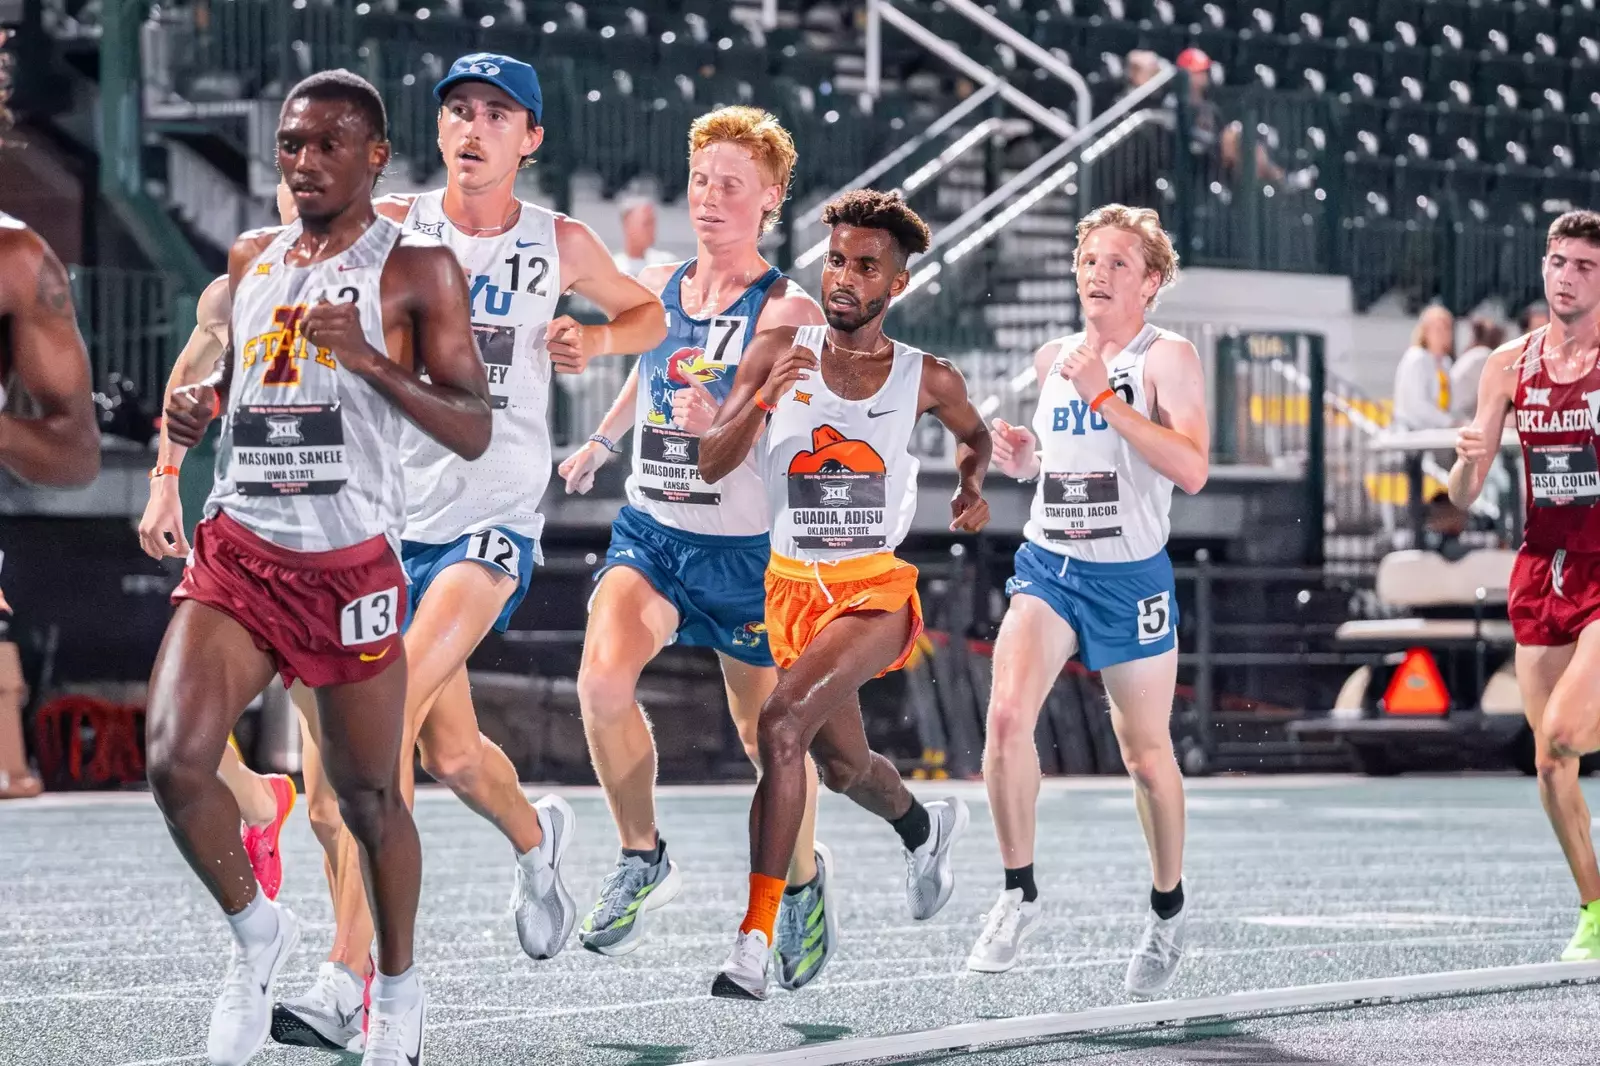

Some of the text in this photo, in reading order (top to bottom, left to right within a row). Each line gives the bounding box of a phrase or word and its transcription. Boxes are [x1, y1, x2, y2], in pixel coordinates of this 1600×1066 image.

[474, 63, 496, 75] Y
[505, 253, 549, 298] 12
[470, 274, 514, 317] YU
[713, 319, 742, 361] 7
[486, 365, 508, 384] EY
[1052, 400, 1109, 436] BYU
[238, 450, 343, 467] MASONDO, SANELE
[264, 469, 315, 480] IOWA STATE
[642, 462, 701, 480] WALSDORF, PE
[663, 481, 690, 491] KANSAS
[1532, 473, 1597, 488] ASO, COLIN
[793, 510, 883, 526] GUADIA, ADISU
[1045, 505, 1118, 519] STANFORD, JACOB
[807, 526, 870, 536] OKLAHOMA STATE
[1070, 521, 1085, 529] BYU
[475, 530, 514, 573] 12
[346, 594, 390, 640] 13
[1142, 595, 1166, 634] 5
